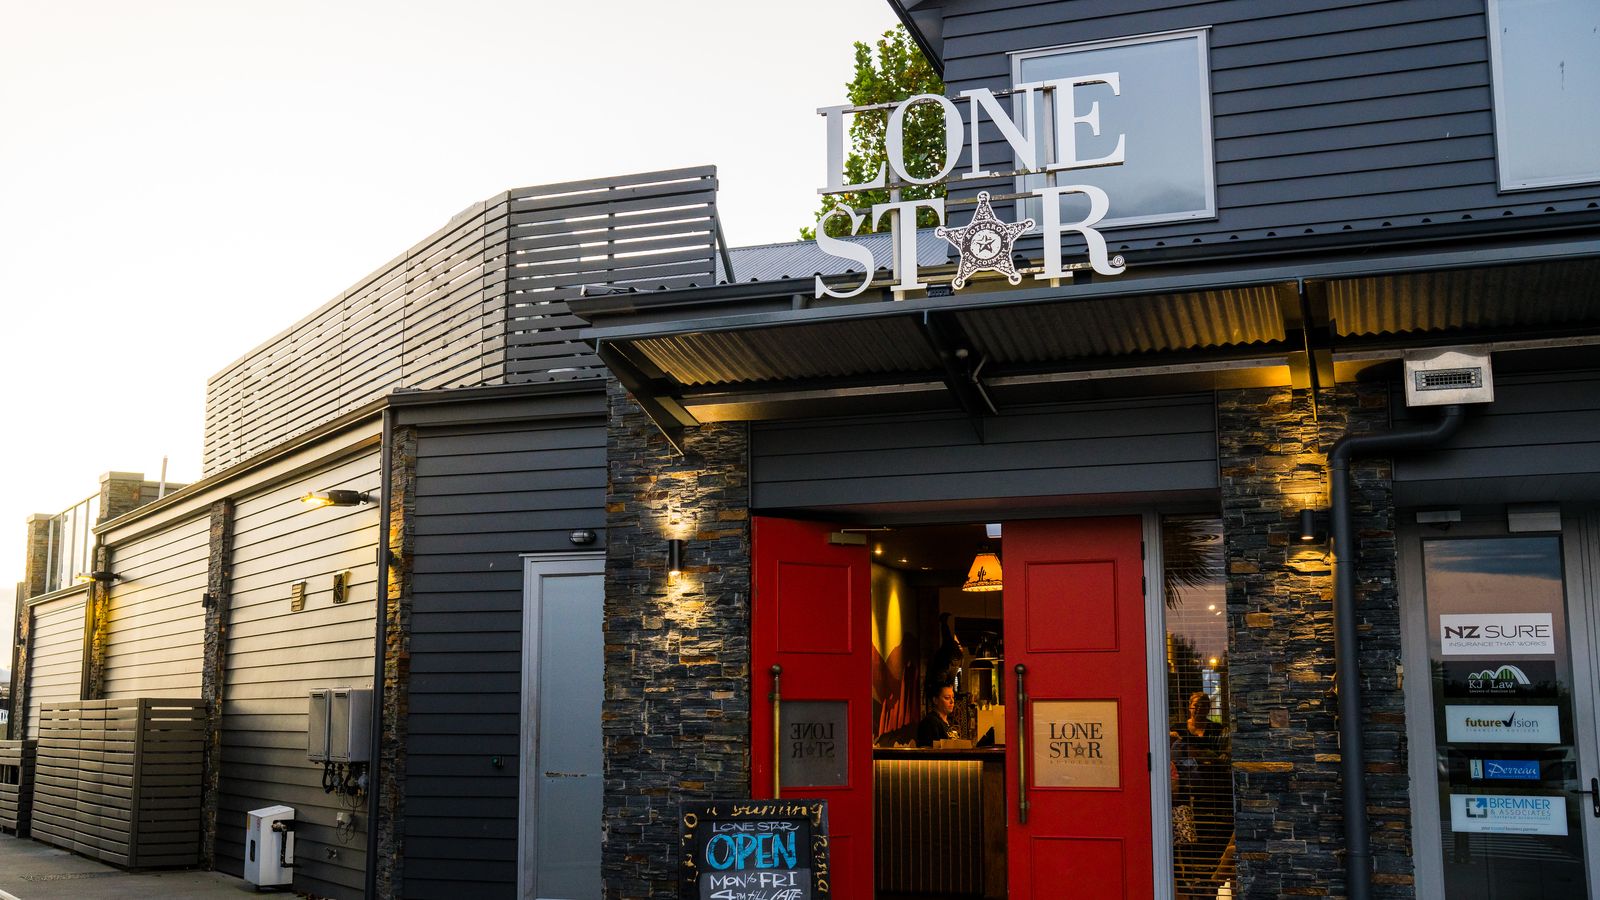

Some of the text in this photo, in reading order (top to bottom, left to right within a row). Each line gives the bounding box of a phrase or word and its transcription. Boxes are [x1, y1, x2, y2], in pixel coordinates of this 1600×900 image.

[816, 71, 1126, 195] LONE
[1444, 624, 1551, 639] NZ SURE
[1468, 679, 1514, 689] KJ Law
[1049, 722, 1103, 740] LONE
[1489, 797, 1551, 810] BREMNER
[1499, 809, 1551, 817] ASSOCIATES
[712, 821, 800, 833] LONE STAR
[705, 831, 798, 871] OPEN
[757, 871, 798, 889] FRI
